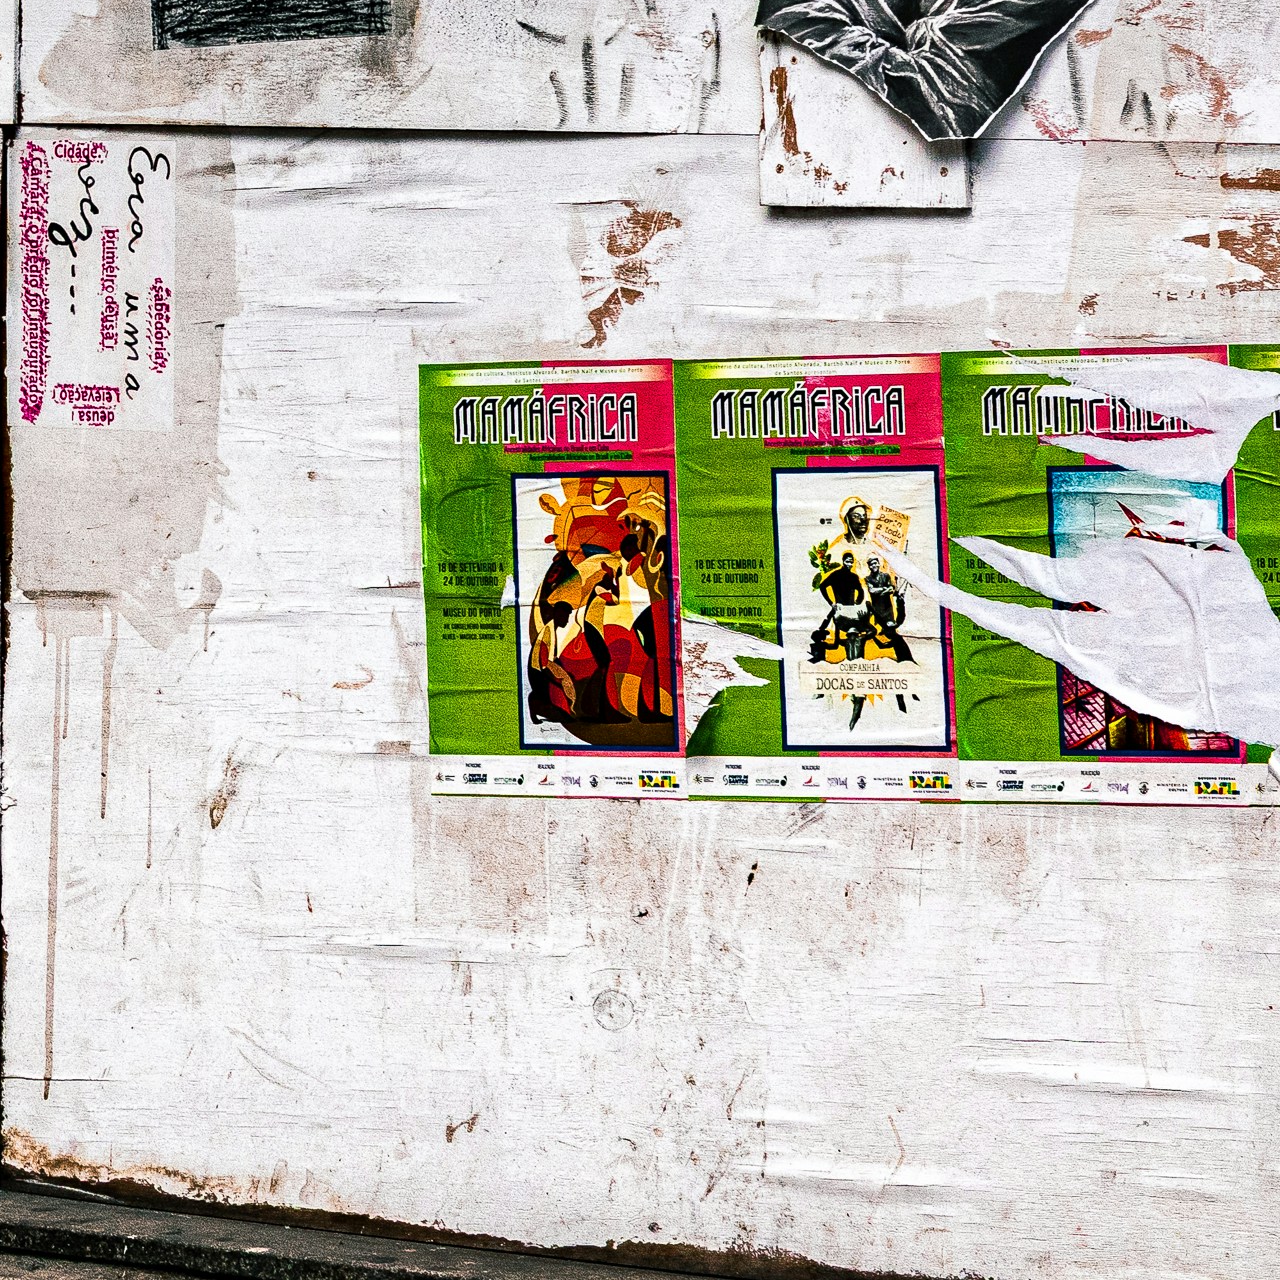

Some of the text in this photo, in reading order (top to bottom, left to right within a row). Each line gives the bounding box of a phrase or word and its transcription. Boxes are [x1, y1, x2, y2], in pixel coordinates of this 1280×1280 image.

[123, 290, 141, 401] uma
[1256, 558, 1266, 568] 18
[972, 572, 983, 584] 24
[1263, 572, 1273, 583] 24
[839, 663, 881, 672] COMPANHIA
[816, 677, 854, 690] DOCAS
[867, 678, 908, 690] SANTOS
